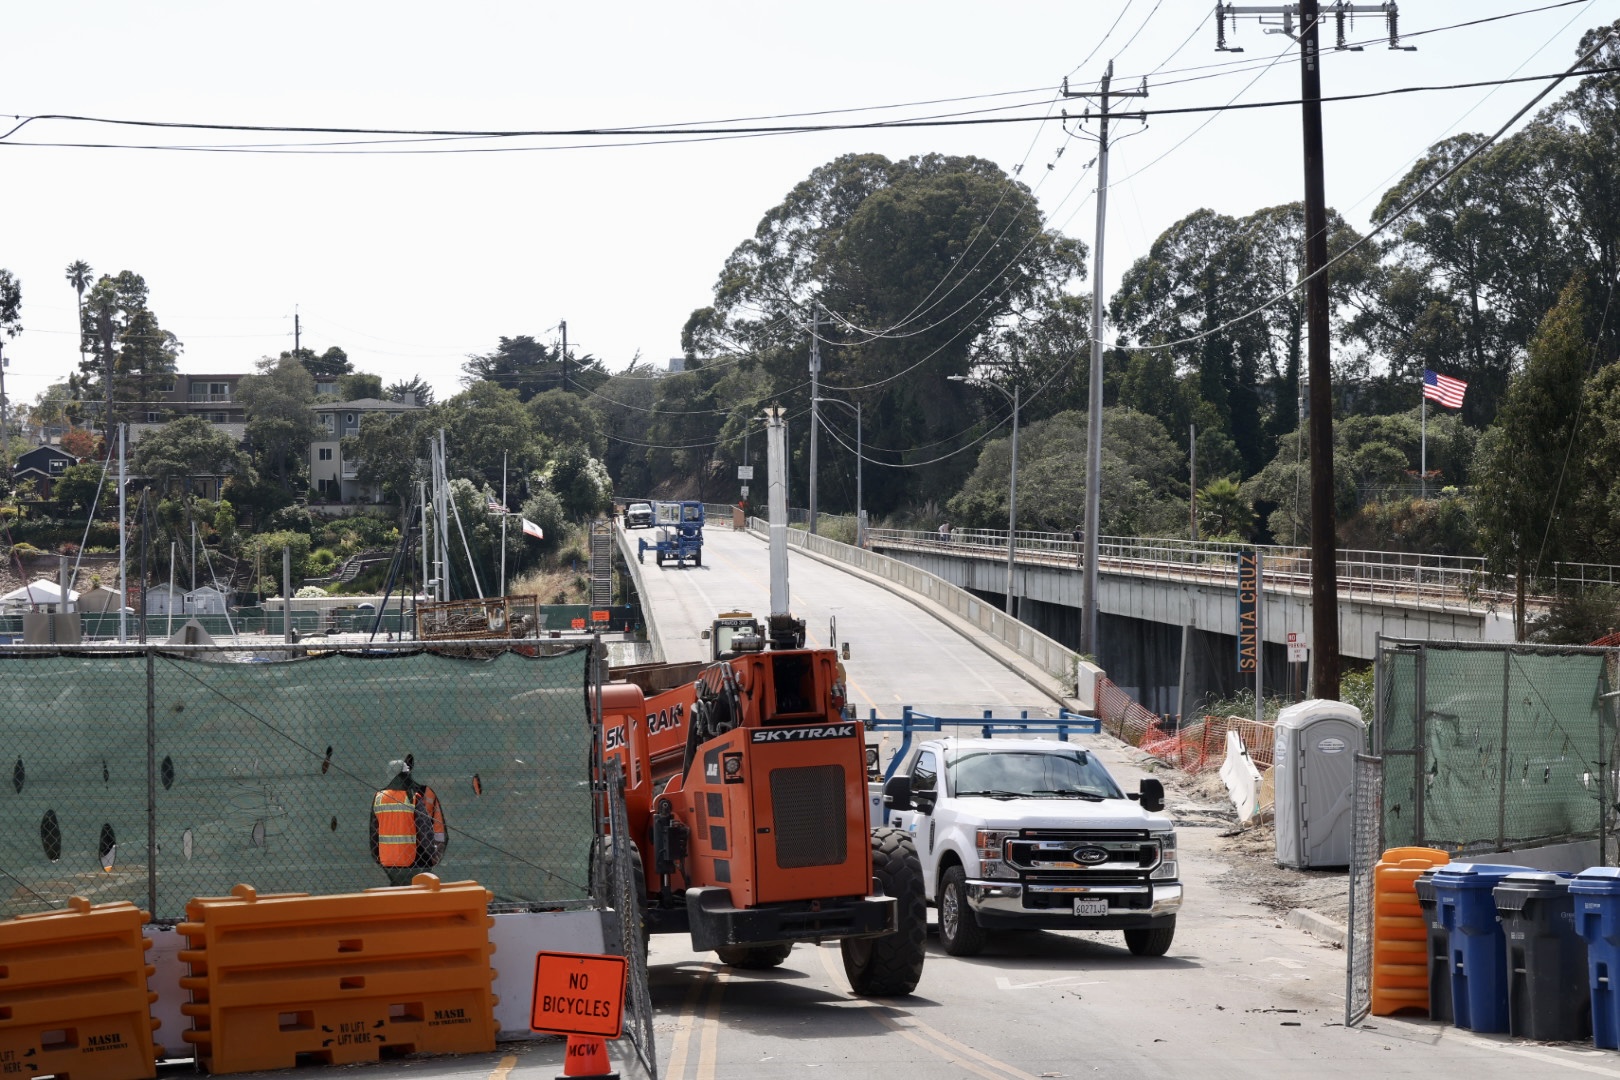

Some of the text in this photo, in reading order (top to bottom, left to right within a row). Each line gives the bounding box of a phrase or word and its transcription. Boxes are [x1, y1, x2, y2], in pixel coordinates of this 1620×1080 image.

[1240, 555, 1256, 669] SANTA CRUZ
[752, 725, 854, 742] SKYTRAK
[1081, 851, 1100, 860] Ford
[569, 972, 589, 991] NO
[542, 995, 611, 1018] BICYCLES
[434, 1008, 464, 1019] MASH
[340, 1021, 365, 1032] NO LIFT
[88, 1033, 121, 1046] MASH
[337, 1033, 371, 1045] LIFT HERE
[569, 1043, 599, 1057] MCW
[3, 1062, 22, 1073] HERE
